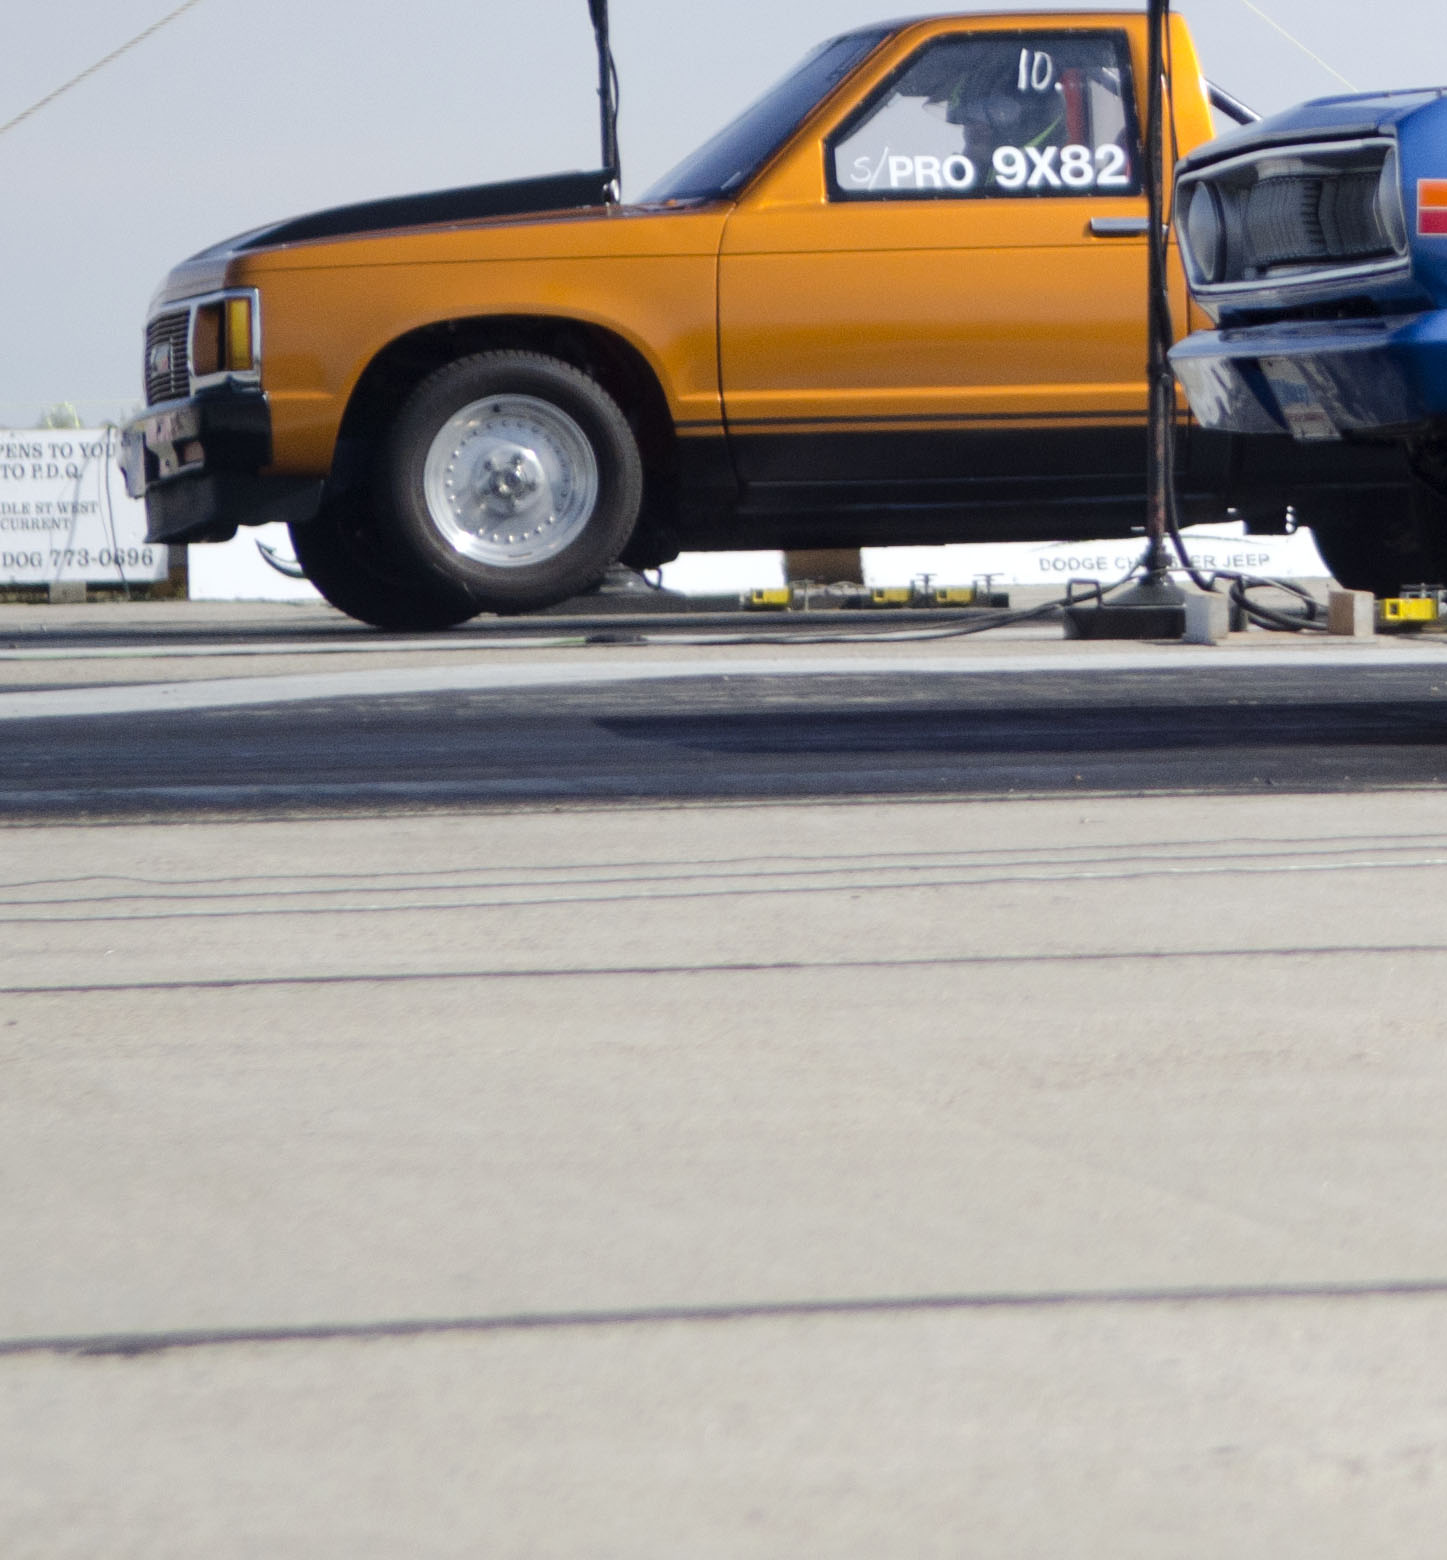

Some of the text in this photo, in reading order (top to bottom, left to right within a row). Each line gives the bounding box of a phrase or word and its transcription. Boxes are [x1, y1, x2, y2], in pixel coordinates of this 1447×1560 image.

[992, 144, 1128, 188] 9X82
[50, 442, 72, 458] TO
[3, 551, 42, 568] DOG
[1039, 556, 1108, 572] DODGE
[1222, 553, 1270, 568] JEEP
